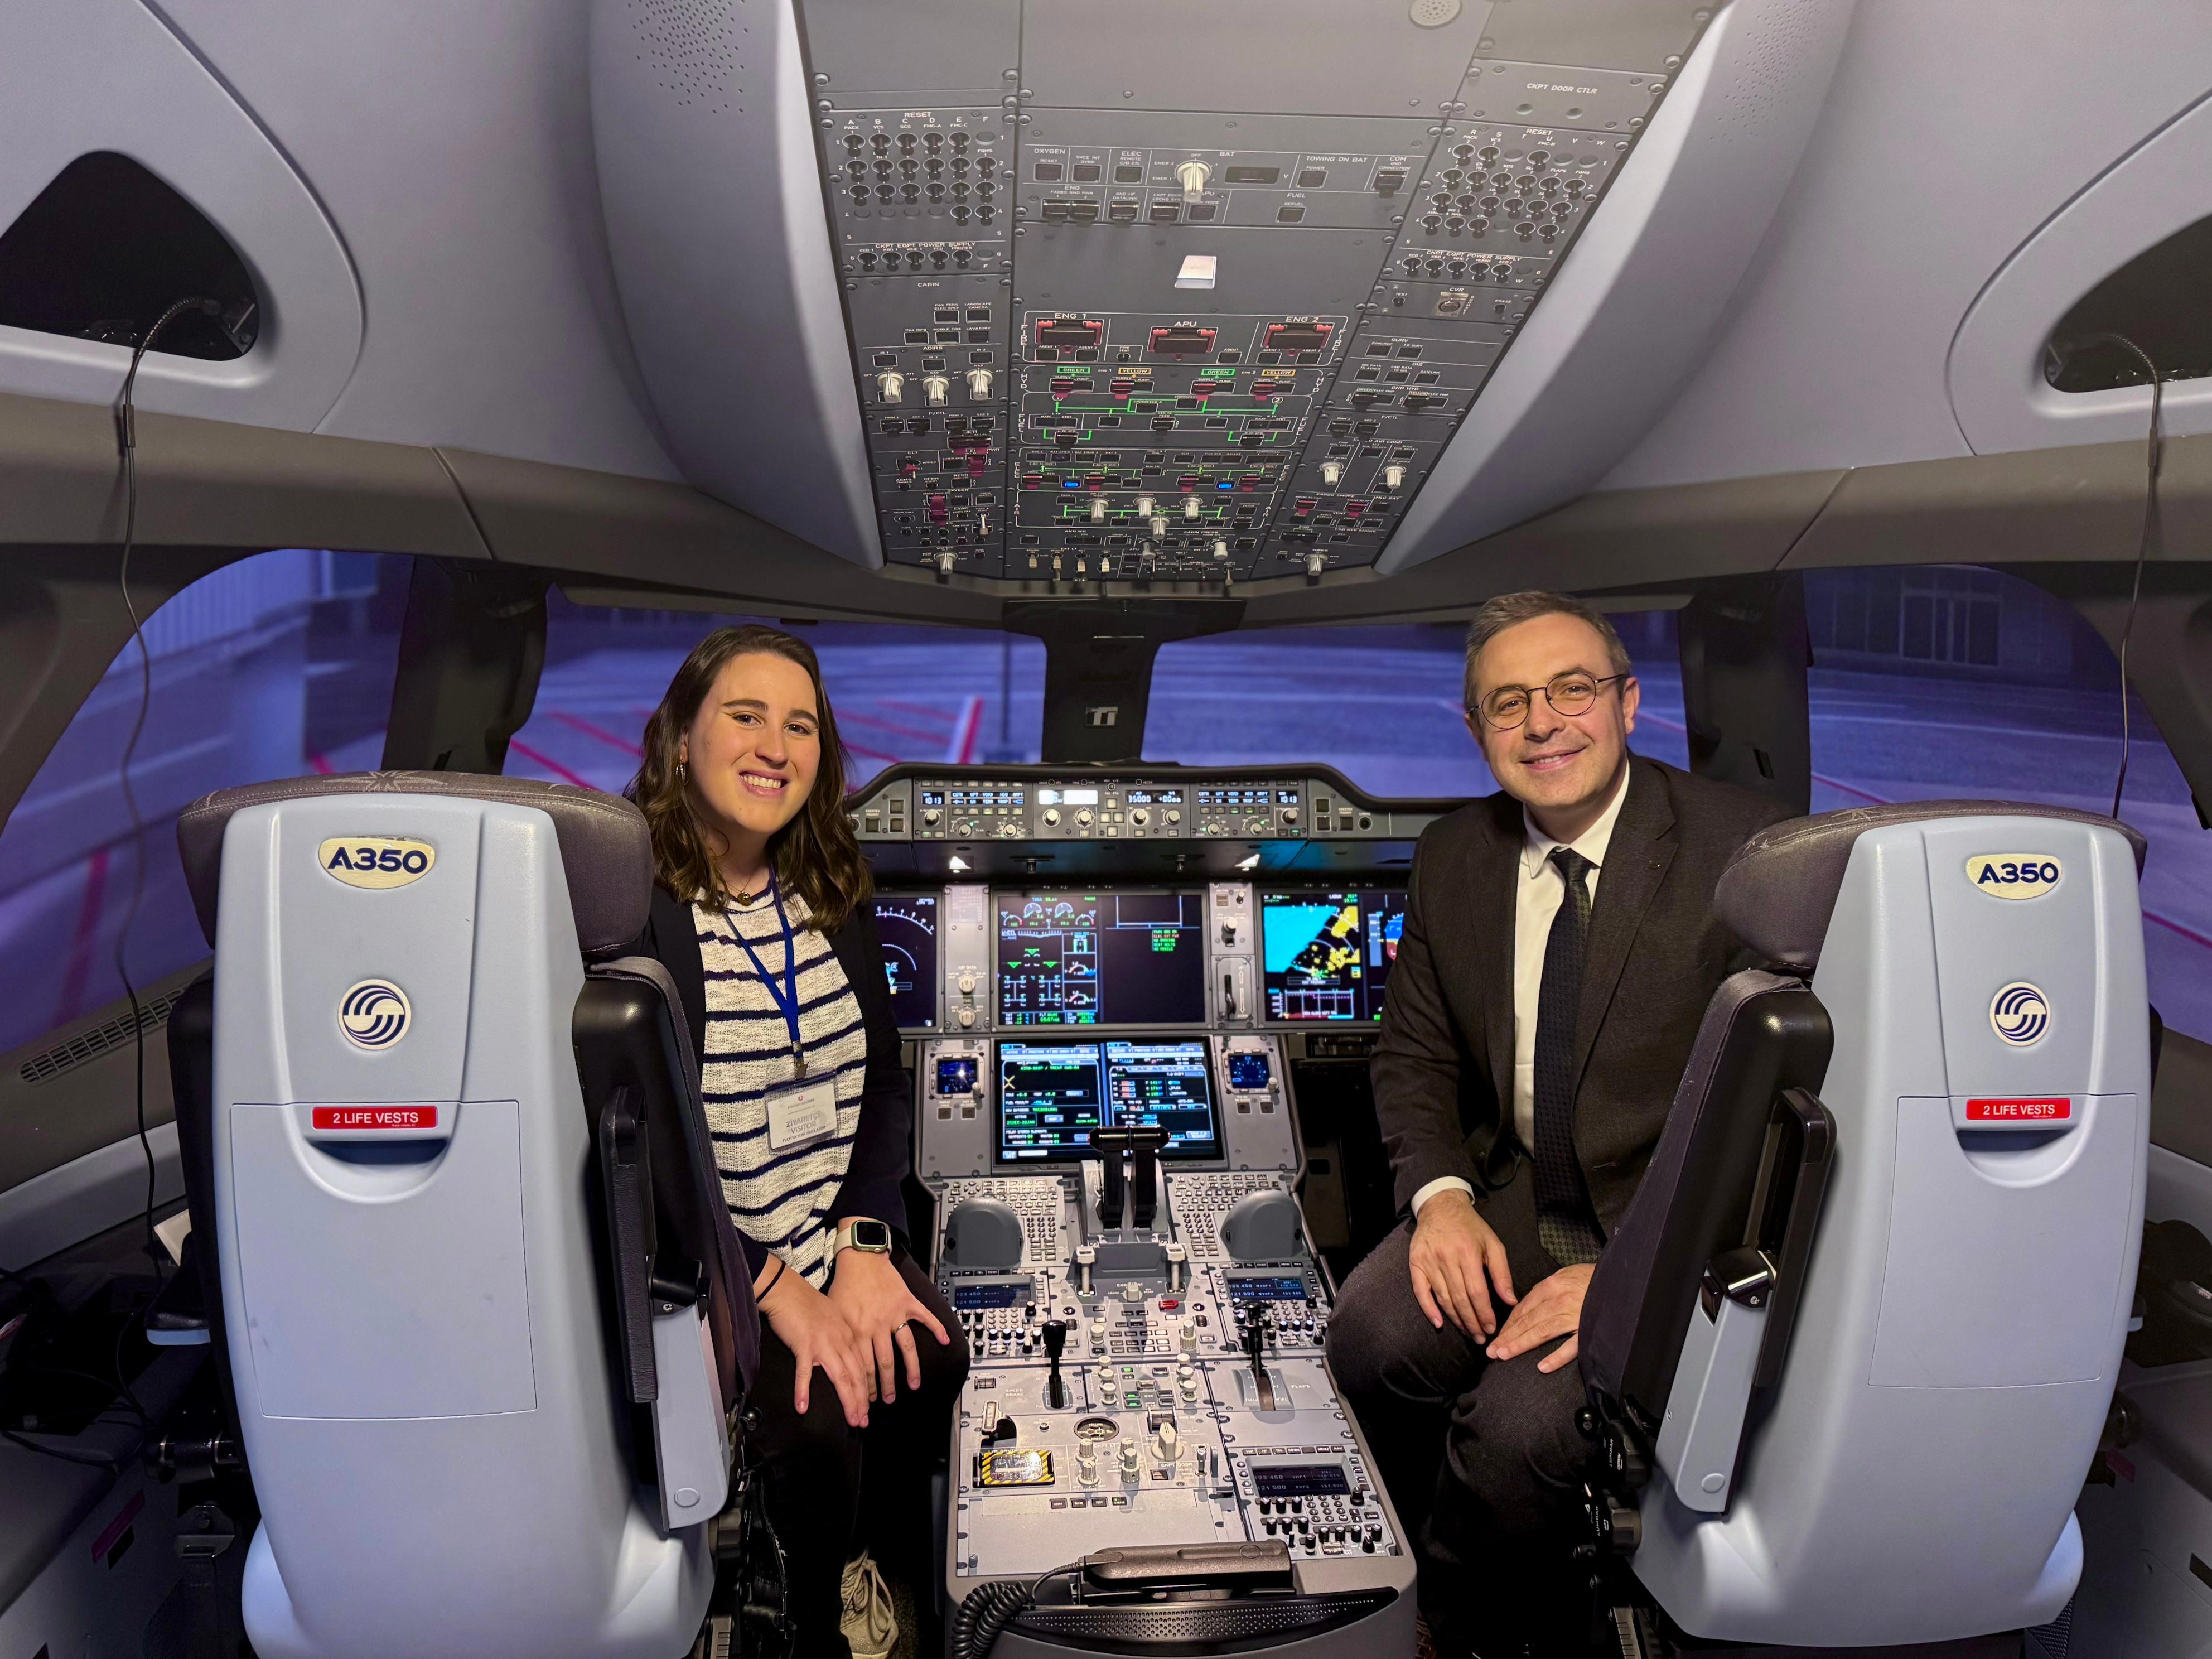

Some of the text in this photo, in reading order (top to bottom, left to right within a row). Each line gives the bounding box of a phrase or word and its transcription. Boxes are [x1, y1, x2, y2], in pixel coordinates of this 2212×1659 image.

[327, 847, 428, 874] A350
[1977, 862, 2059, 884] A350
[1983, 1104, 2056, 1115] 2 LIFE VESTS
[333, 1112, 419, 1124] 2 LIFE VESTS
[791, 1121, 817, 1134] VISITOR
